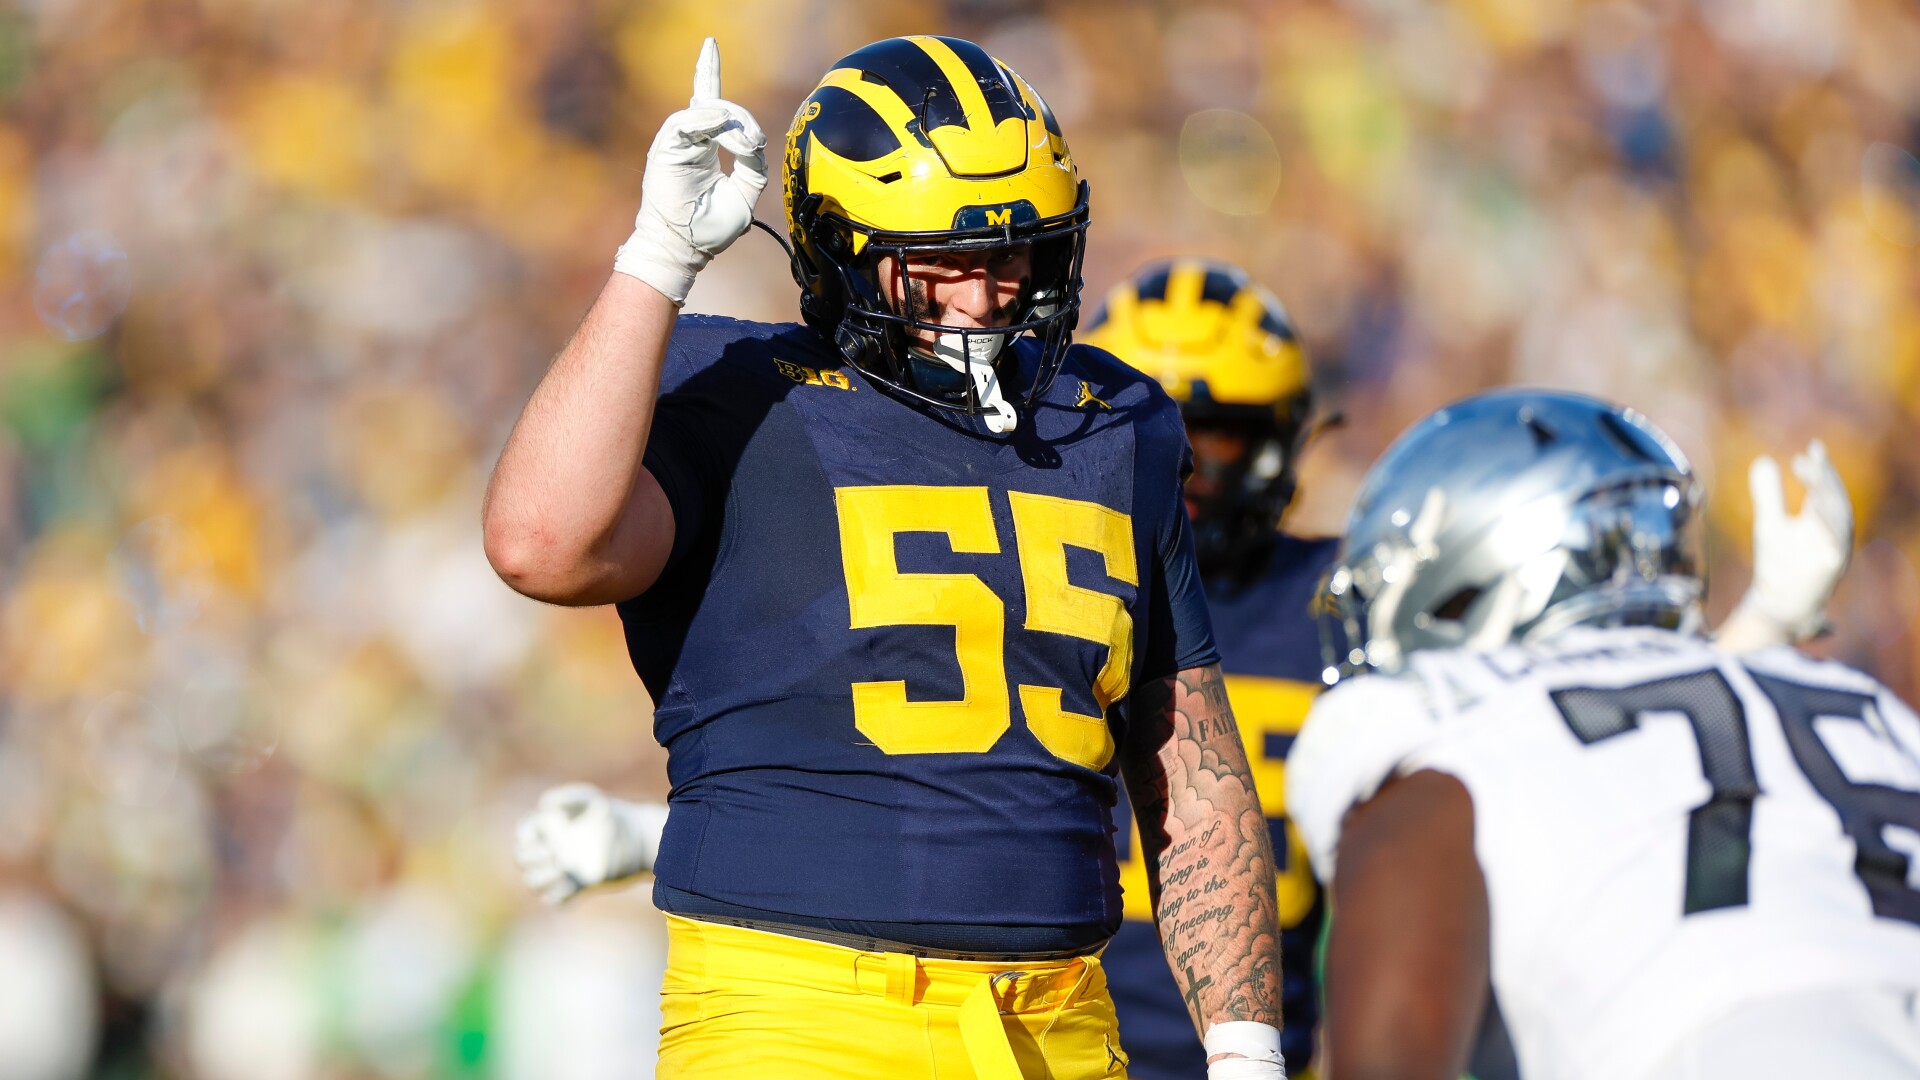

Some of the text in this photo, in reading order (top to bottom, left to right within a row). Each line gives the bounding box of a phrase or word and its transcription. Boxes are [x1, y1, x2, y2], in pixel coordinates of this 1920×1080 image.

[985, 208, 1012, 226] M
[834, 485, 1139, 771] 55
[1199, 820, 1221, 848] of
[1197, 855, 1209, 871] is
[1186, 886, 1201, 902] to
[1204, 874, 1229, 894] the
[1179, 904, 1235, 935] meeting
[1176, 940, 1208, 971] again
